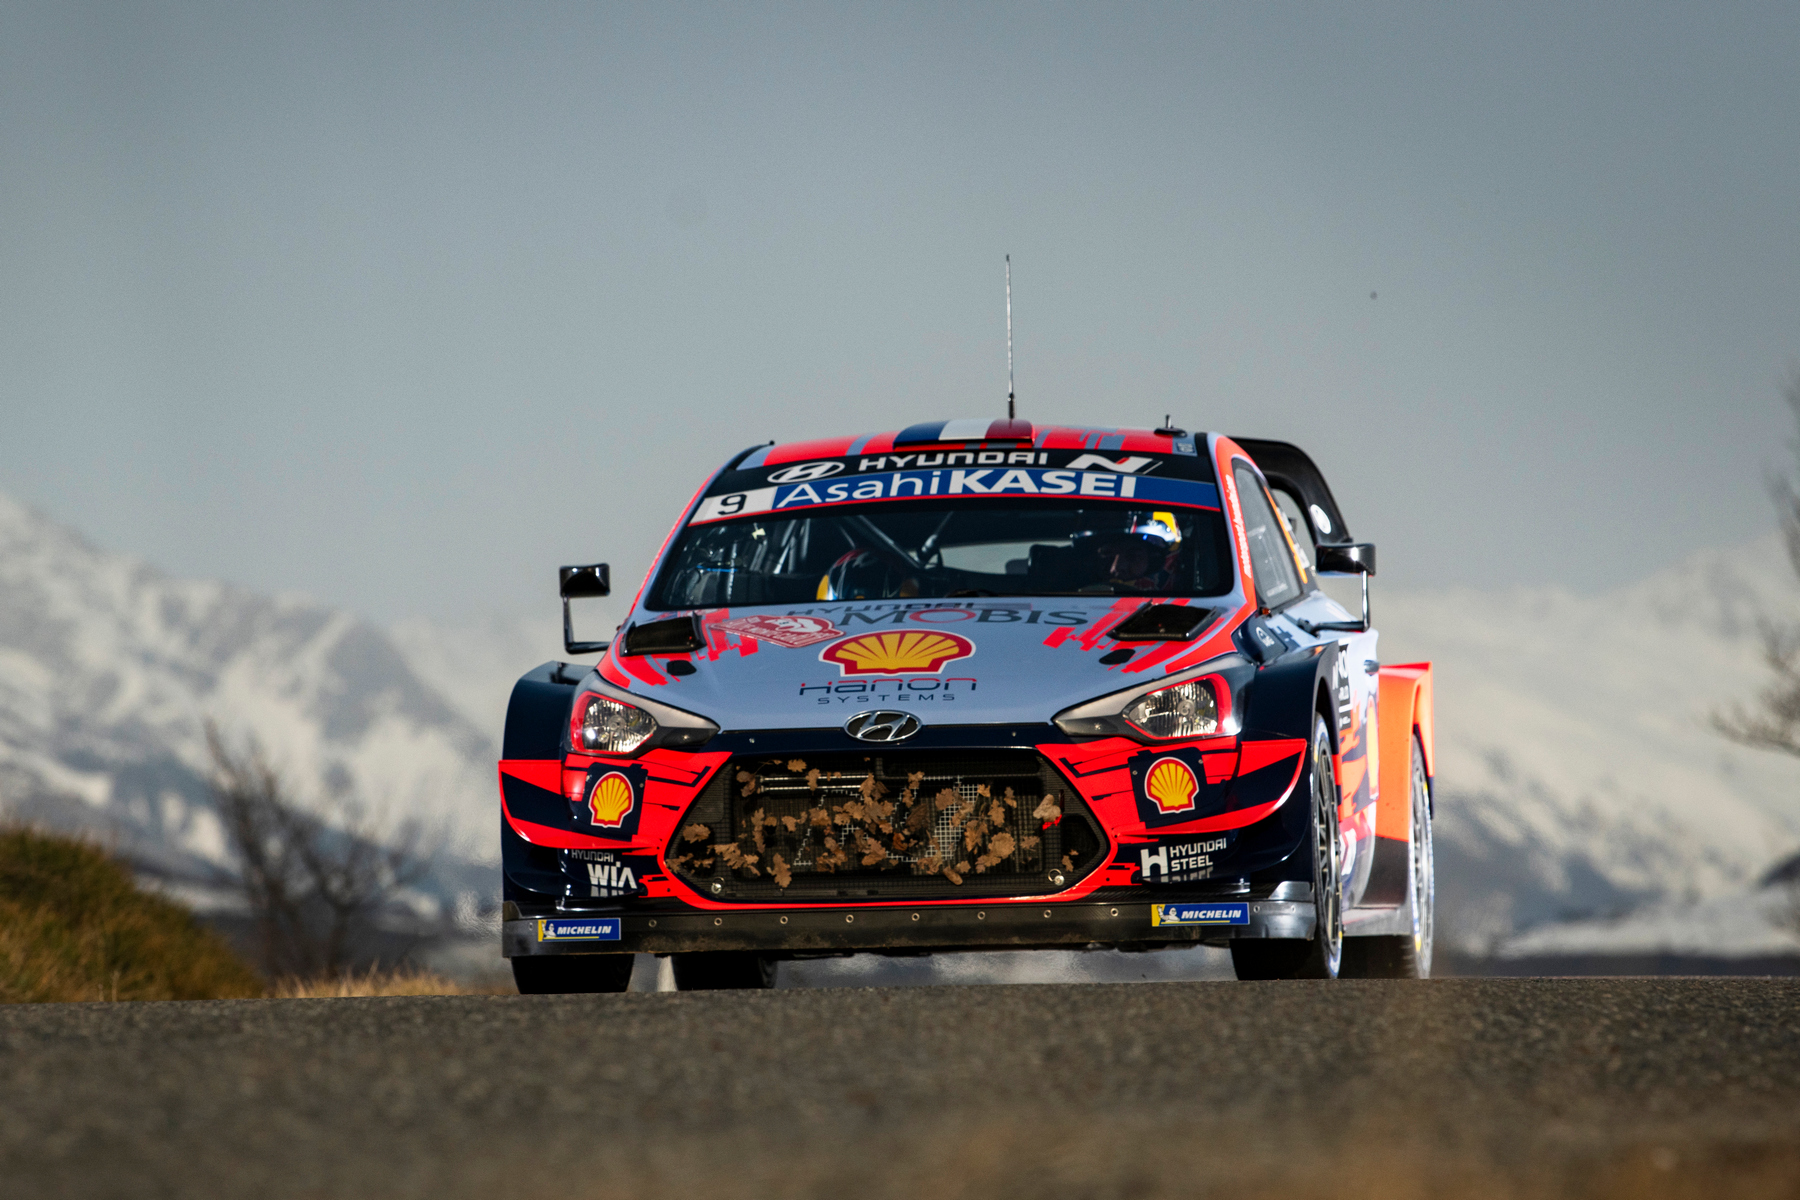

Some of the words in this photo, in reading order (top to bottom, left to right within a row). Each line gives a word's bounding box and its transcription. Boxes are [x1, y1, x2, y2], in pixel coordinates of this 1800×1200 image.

[858, 452, 1048, 471] HYUNDAI
[717, 494, 748, 516] 9
[787, 602, 974, 616] HYUNDAI
[837, 607, 1089, 626] MOBIS
[817, 693, 956, 705] SYSTEMS
[1170, 837, 1227, 858] HYUNDAI
[571, 849, 614, 863] HYUNDAI
[1171, 855, 1213, 872] STEEL
[1181, 909, 1242, 919] MICHELIN
[557, 925, 612, 935] MICHELIN
